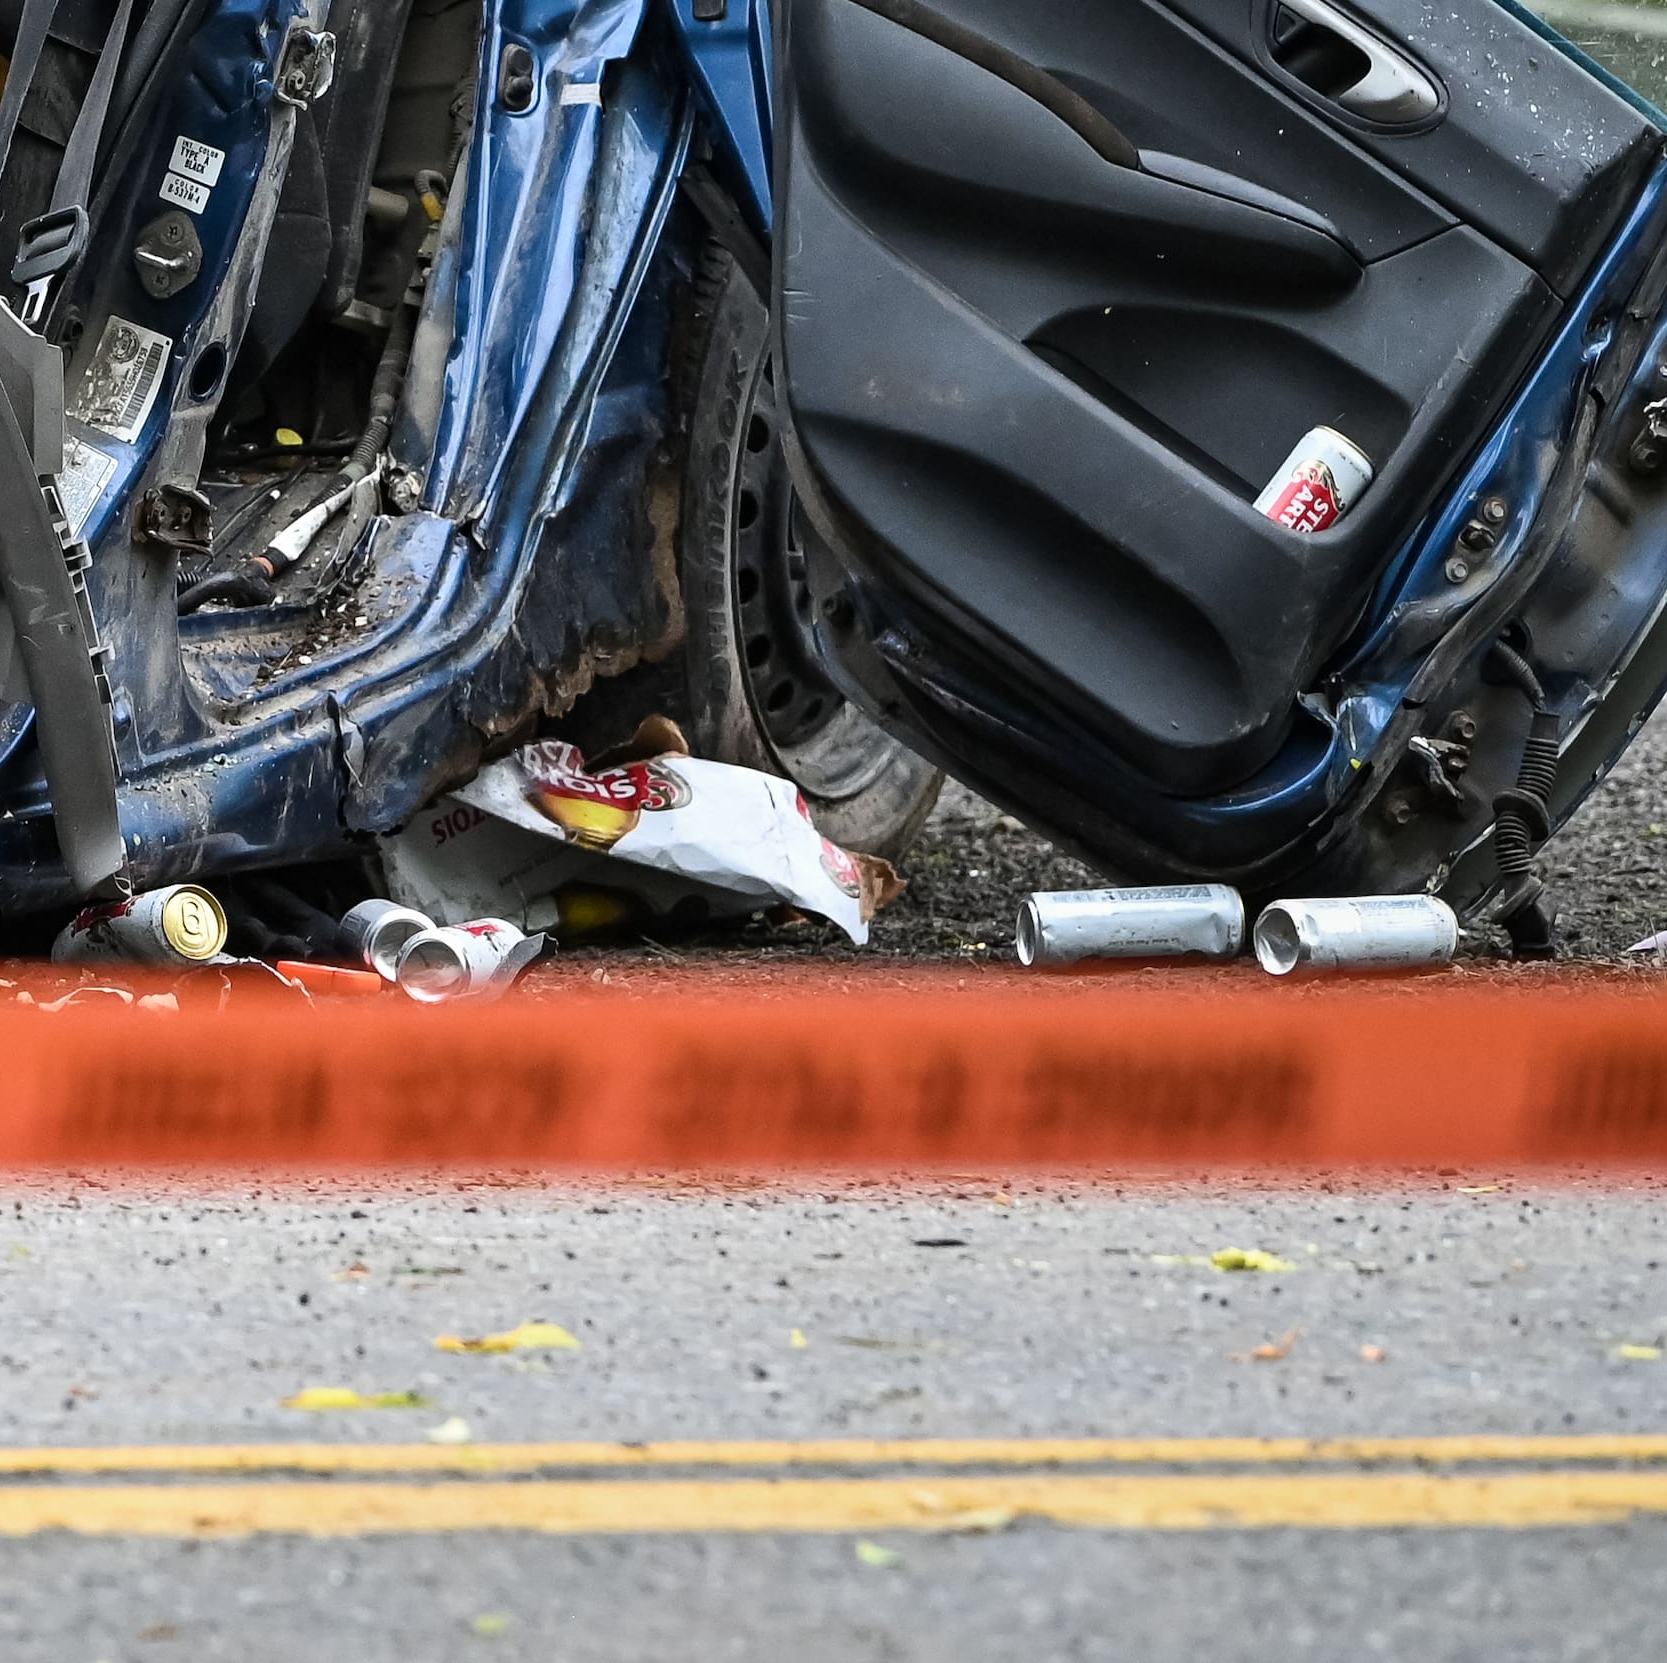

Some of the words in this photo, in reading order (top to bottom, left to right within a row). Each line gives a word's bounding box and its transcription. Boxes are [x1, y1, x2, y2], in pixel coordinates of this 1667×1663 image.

[180, 146, 199, 161] TYPE
[204, 156, 210, 167] A
[184, 159, 206, 174] BLACK
[174, 179, 199, 193] COLOR
[1279, 484, 1314, 529] ART
[1296, 498, 1329, 533] STE
[431, 806, 486, 845] TOIS
